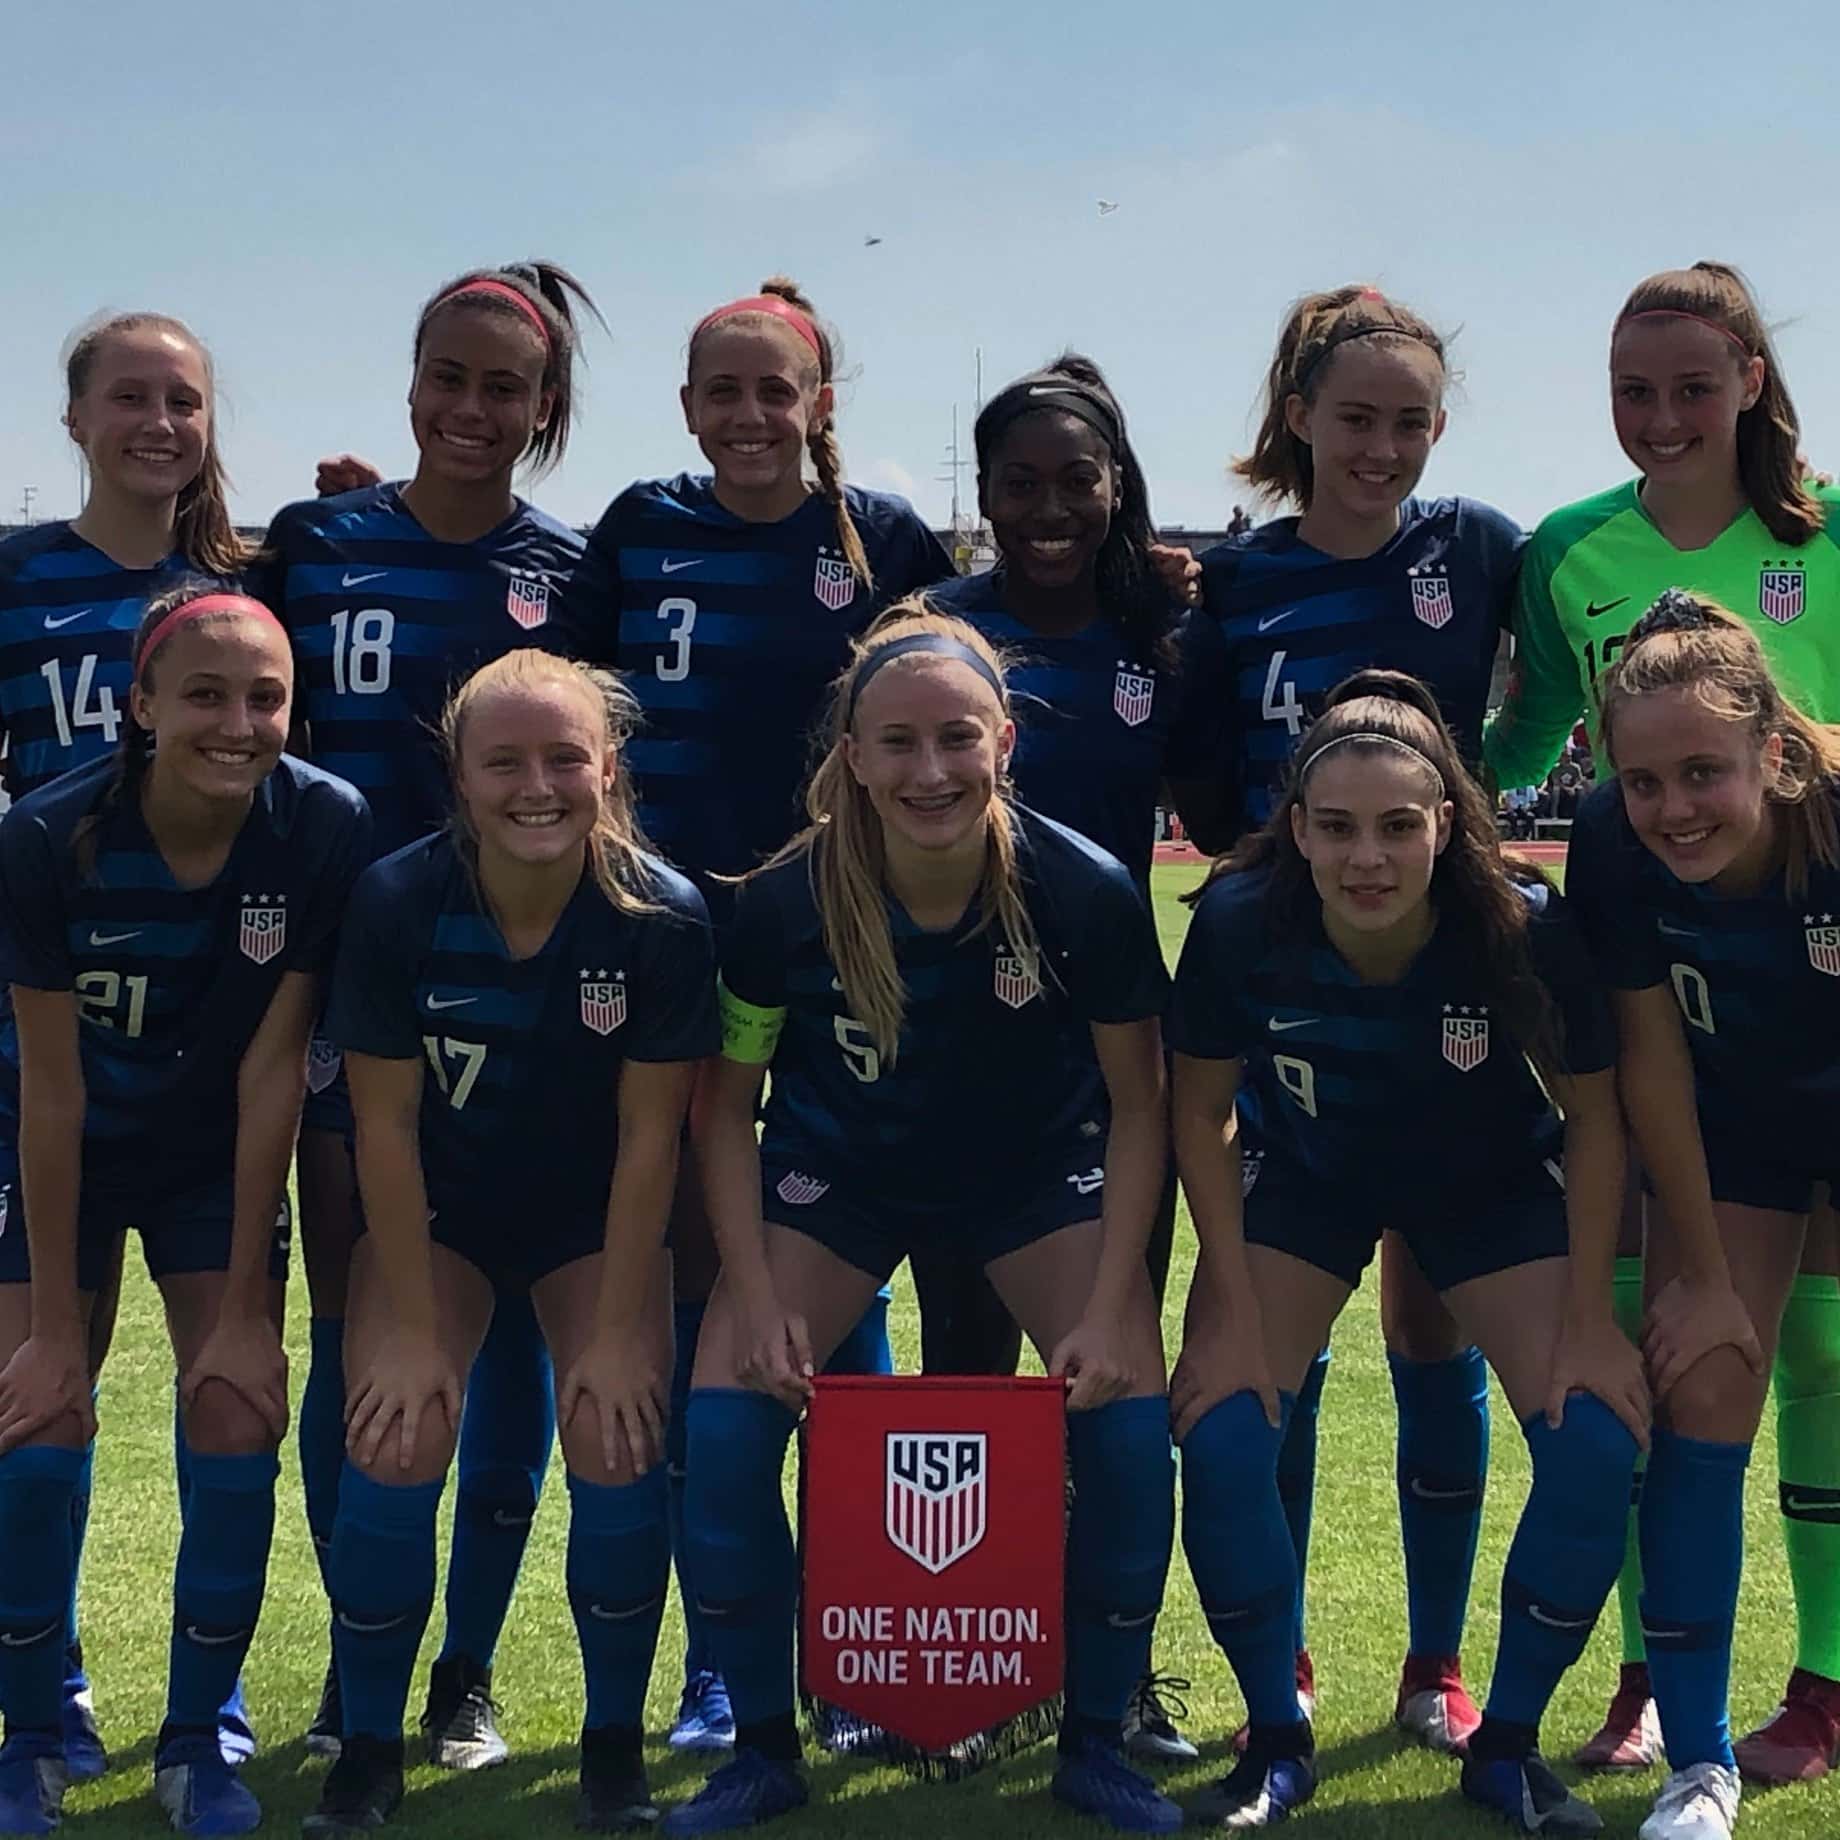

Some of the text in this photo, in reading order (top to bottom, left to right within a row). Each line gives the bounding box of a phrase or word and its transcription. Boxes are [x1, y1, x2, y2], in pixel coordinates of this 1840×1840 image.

[819, 559, 853, 582] USA
[1765, 575, 1801, 594] USA
[512, 581, 547, 602] USA
[1414, 581, 1447, 600] USA
[330, 607, 396, 695] 18
[655, 597, 697, 682] 3
[40, 653, 123, 747] 14
[1117, 673, 1152, 698] USA
[1262, 650, 1304, 736] 4
[244, 911, 284, 931] USA
[76, 969, 148, 1039] 21
[584, 985, 622, 1004] USA
[833, 1014, 880, 1083] 5
[1446, 1021, 1485, 1041] USA
[422, 1034, 487, 1110] 17
[1273, 1054, 1317, 1118] 9
[893, 1441, 979, 1493] USA
[822, 1606, 1047, 1643] ONE NATION.
[836, 1649, 1032, 1686] ONE TEAM.
